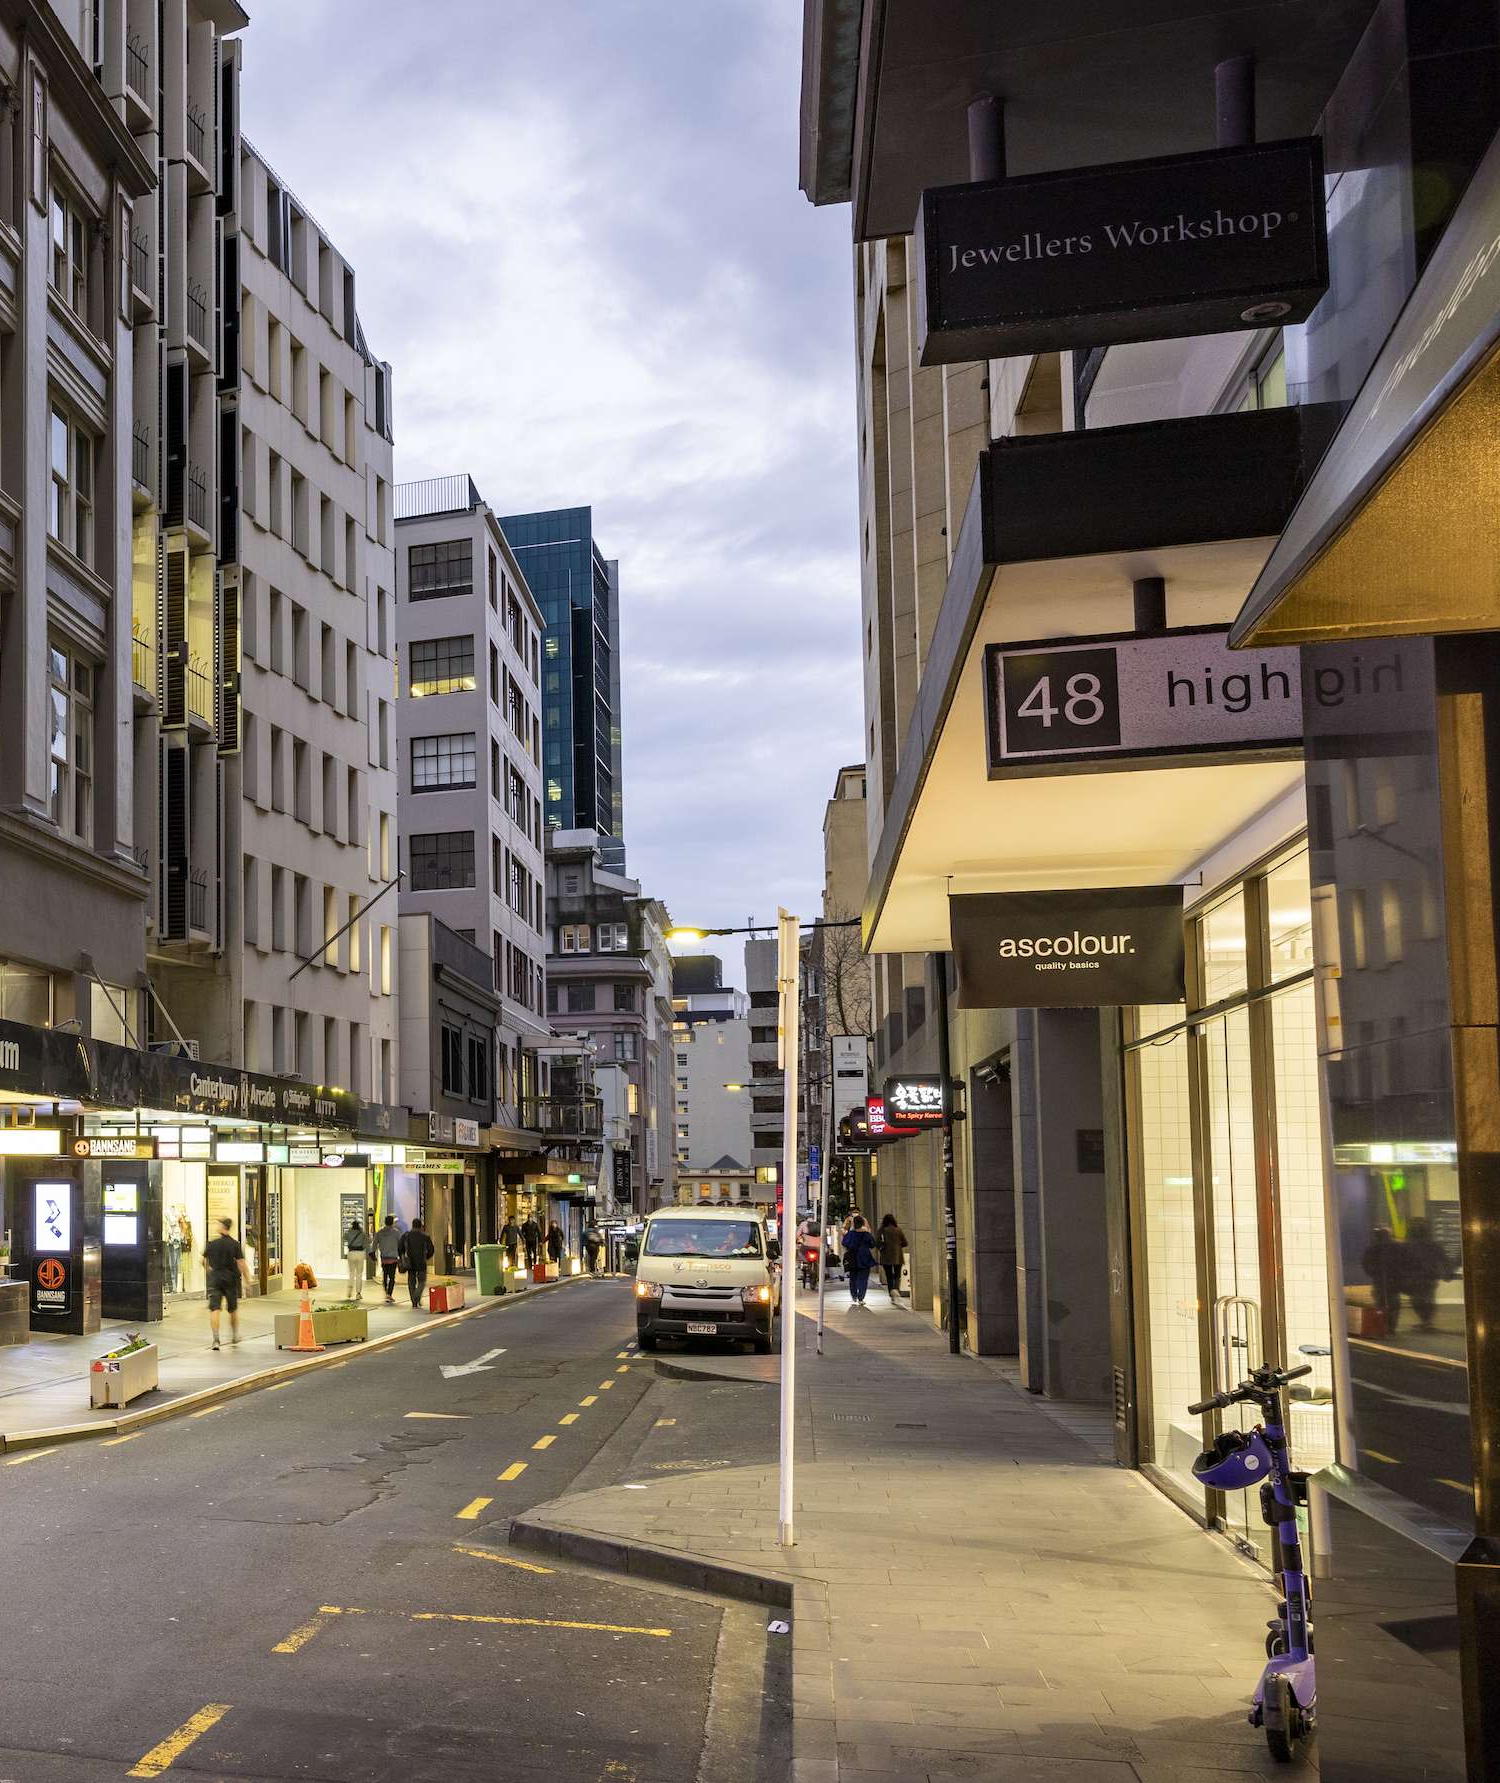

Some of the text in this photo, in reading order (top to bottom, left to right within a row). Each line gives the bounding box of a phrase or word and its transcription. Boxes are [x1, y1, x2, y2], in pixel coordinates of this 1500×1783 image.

[950, 210, 1282, 273] Jewellers Workshop
[1016, 662, 1290, 727] 48 high
[999, 931, 1136, 958] ascolour.
[1035, 961, 1100, 971] quality basics
[190, 1072, 238, 1108] Canterbury
[250, 1084, 276, 1108] Arcade
[907, 1112, 924, 1120] Spicy
[90, 1140, 136, 1153] BANNSANG
